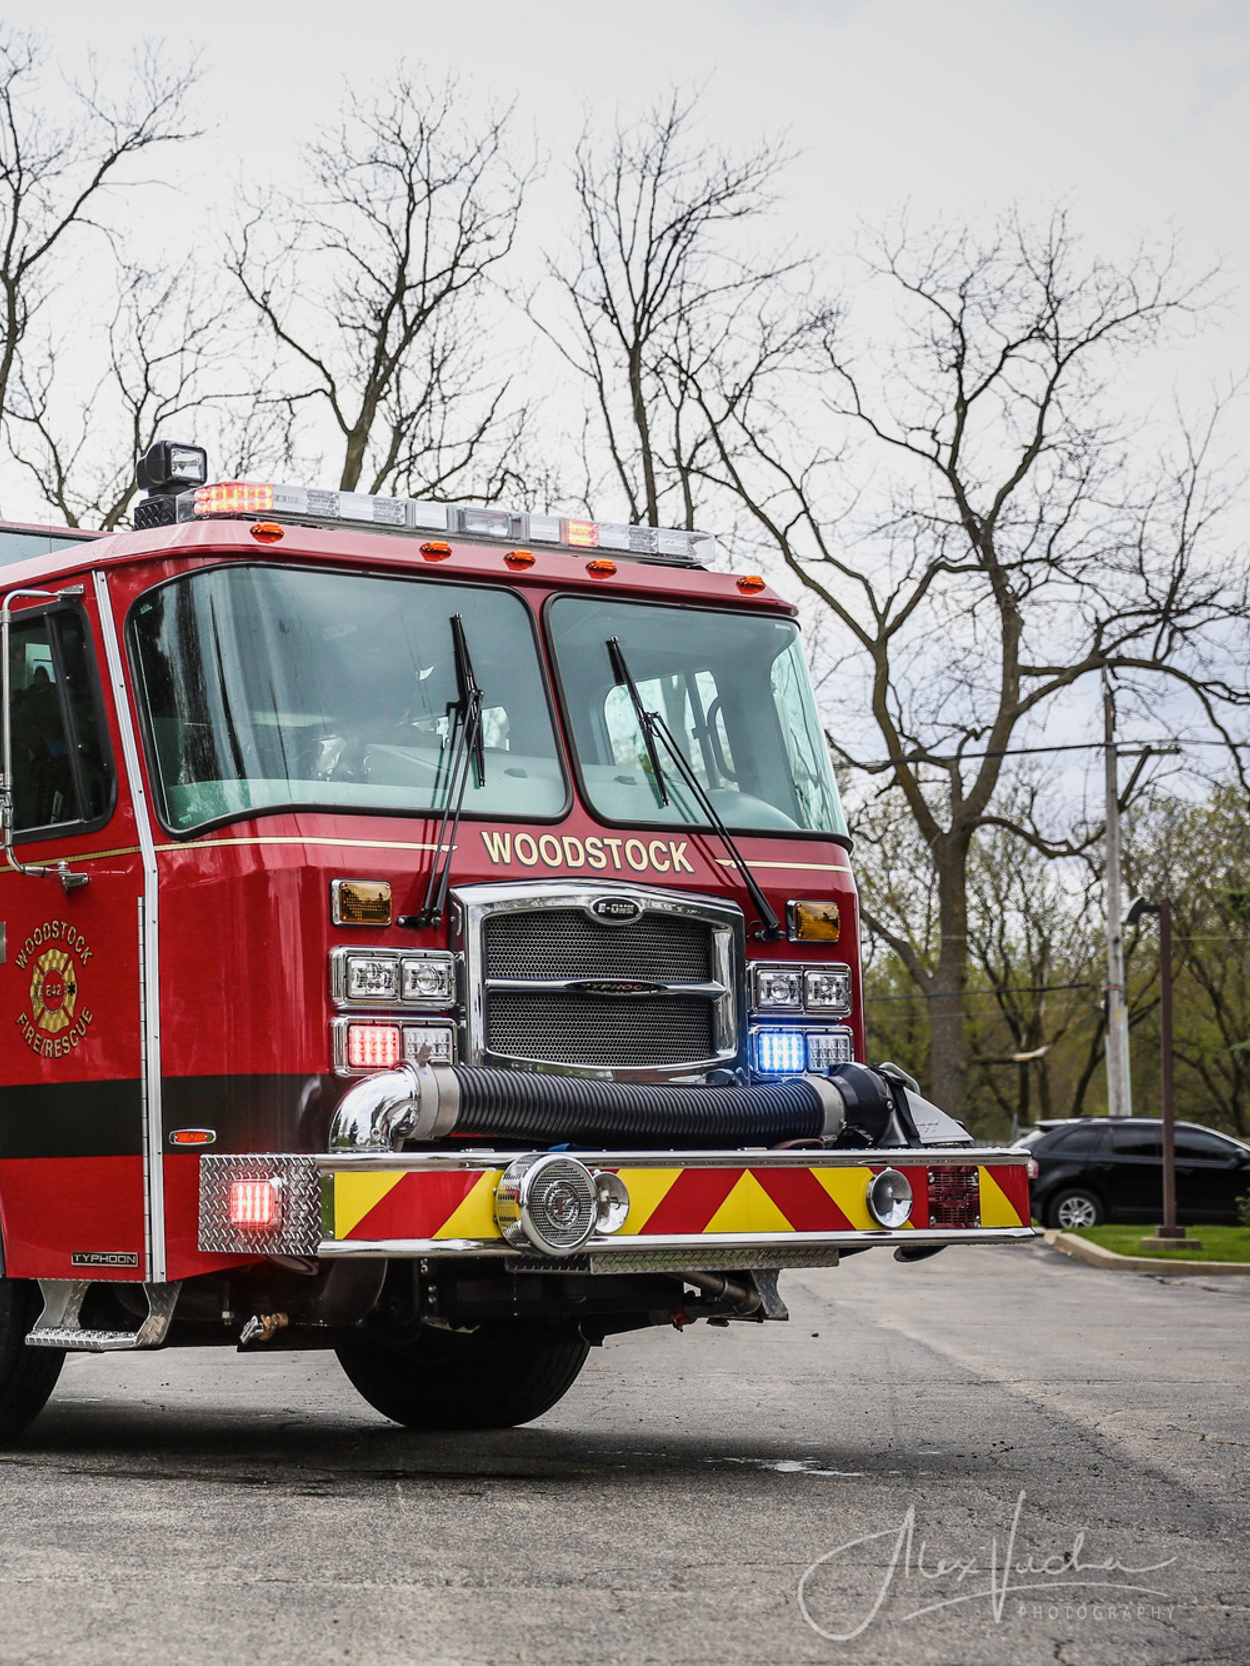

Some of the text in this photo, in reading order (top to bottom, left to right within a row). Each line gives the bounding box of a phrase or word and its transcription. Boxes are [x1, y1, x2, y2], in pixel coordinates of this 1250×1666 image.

[481, 831, 695, 873] WOODSTOCK
[15, 920, 93, 970] WOODSTOCK
[45, 984, 63, 997] E42
[16, 1006, 93, 1058] FIRE/RESCUE
[74, 1254, 136, 1264] TYPHOON
